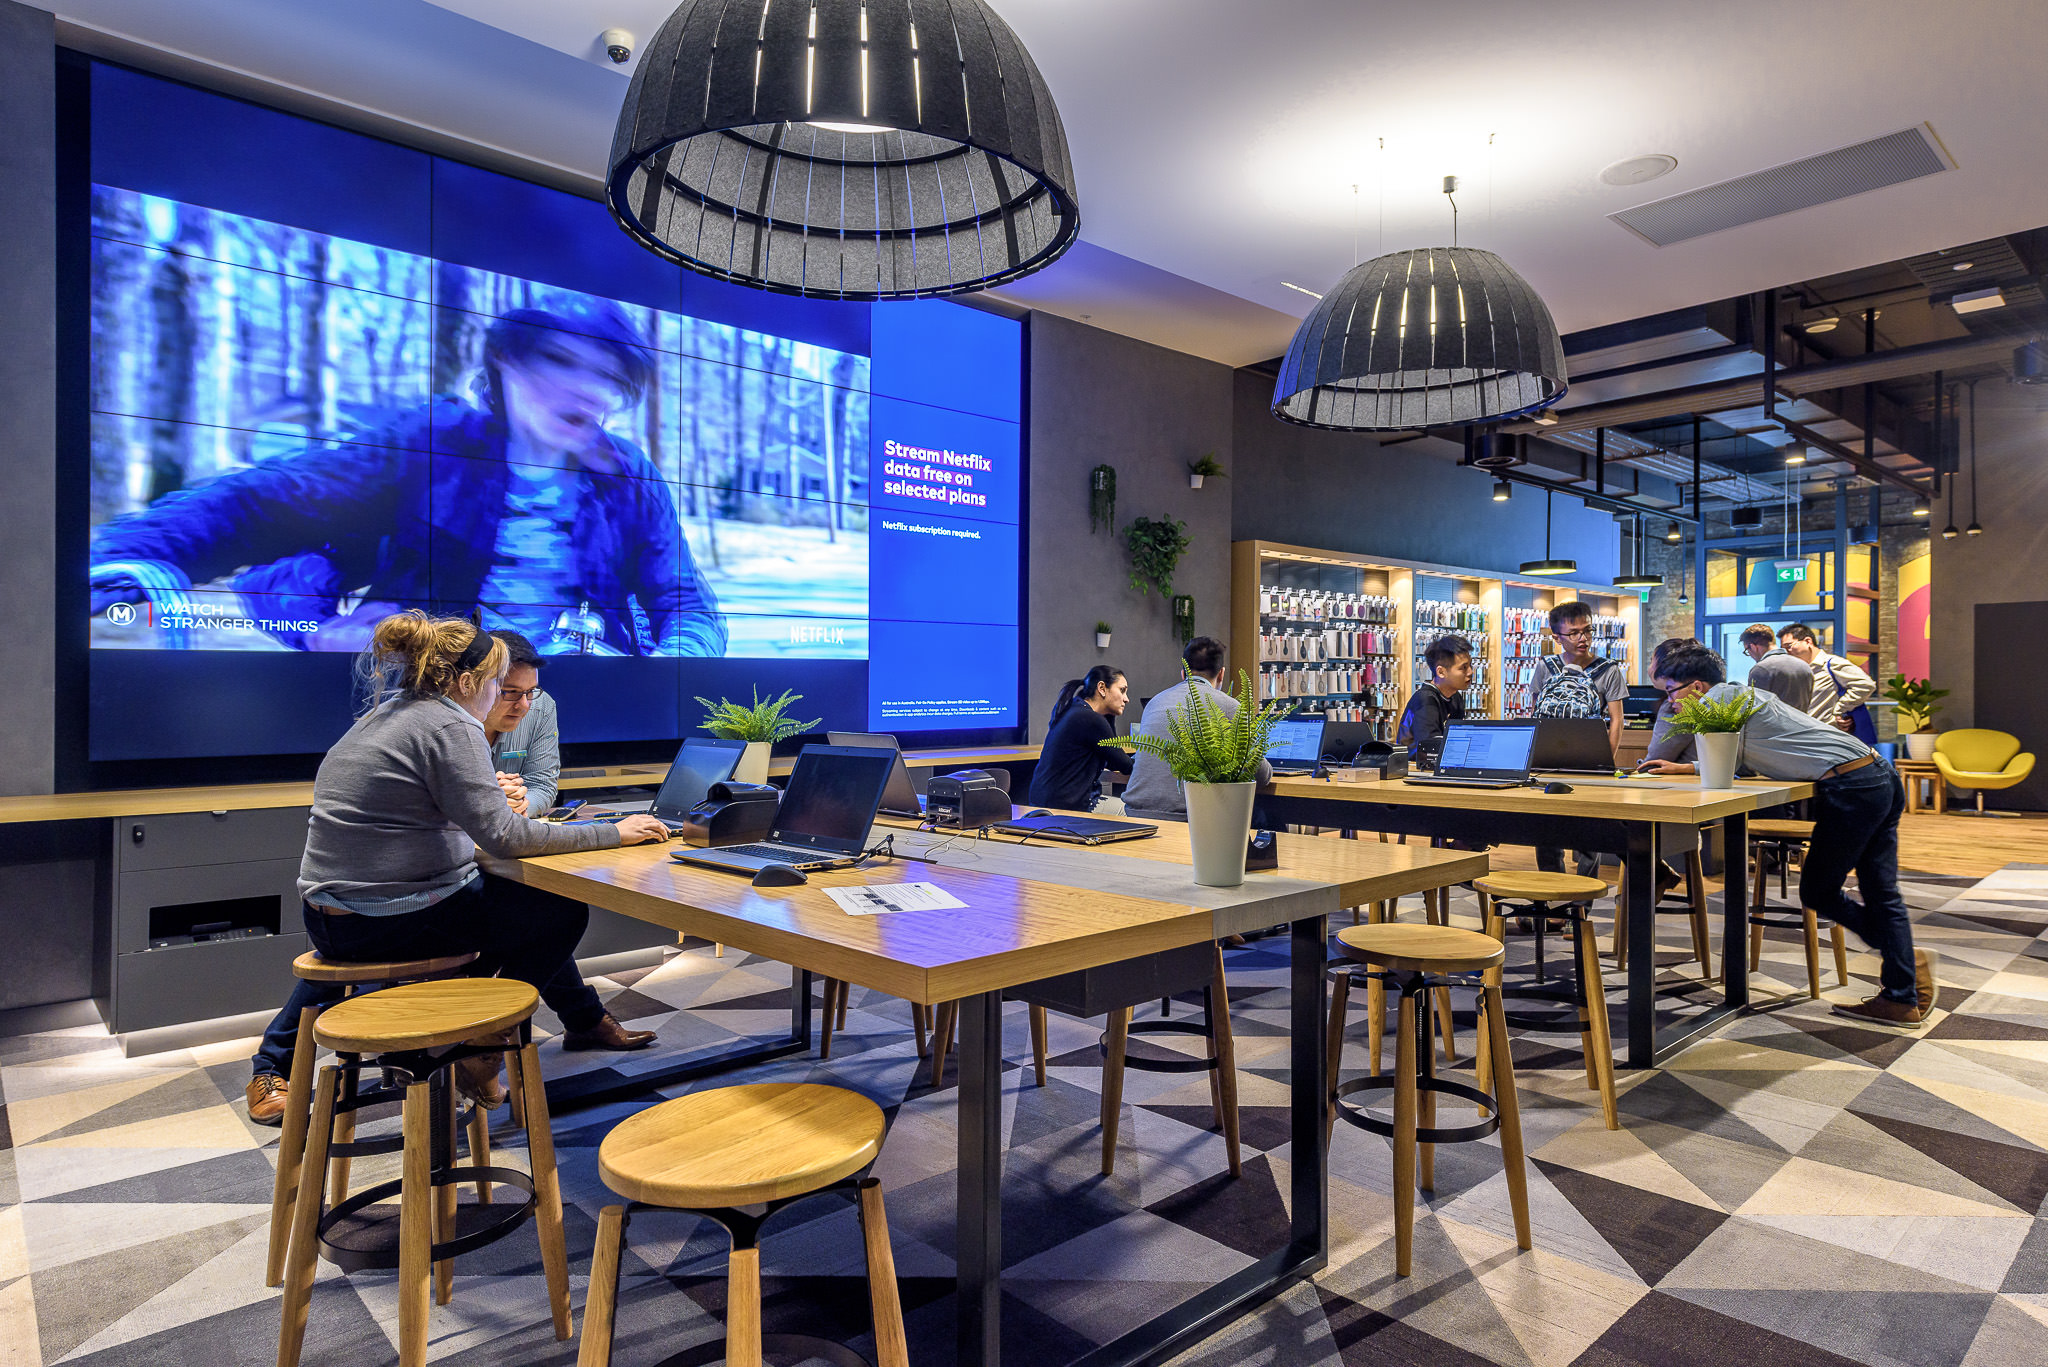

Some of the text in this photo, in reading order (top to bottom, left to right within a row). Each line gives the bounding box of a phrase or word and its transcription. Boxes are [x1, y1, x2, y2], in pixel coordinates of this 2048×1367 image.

[885, 440, 991, 471] Stream Netflix
[885, 460, 972, 486] data free on
[885, 480, 986, 505] selected plans
[882, 521, 981, 539] Netflix subscription required.
[160, 603, 224, 616] WATCH
[160, 617, 319, 632] STRANGER THINGS
[790, 626, 844, 645] NETFLIX
